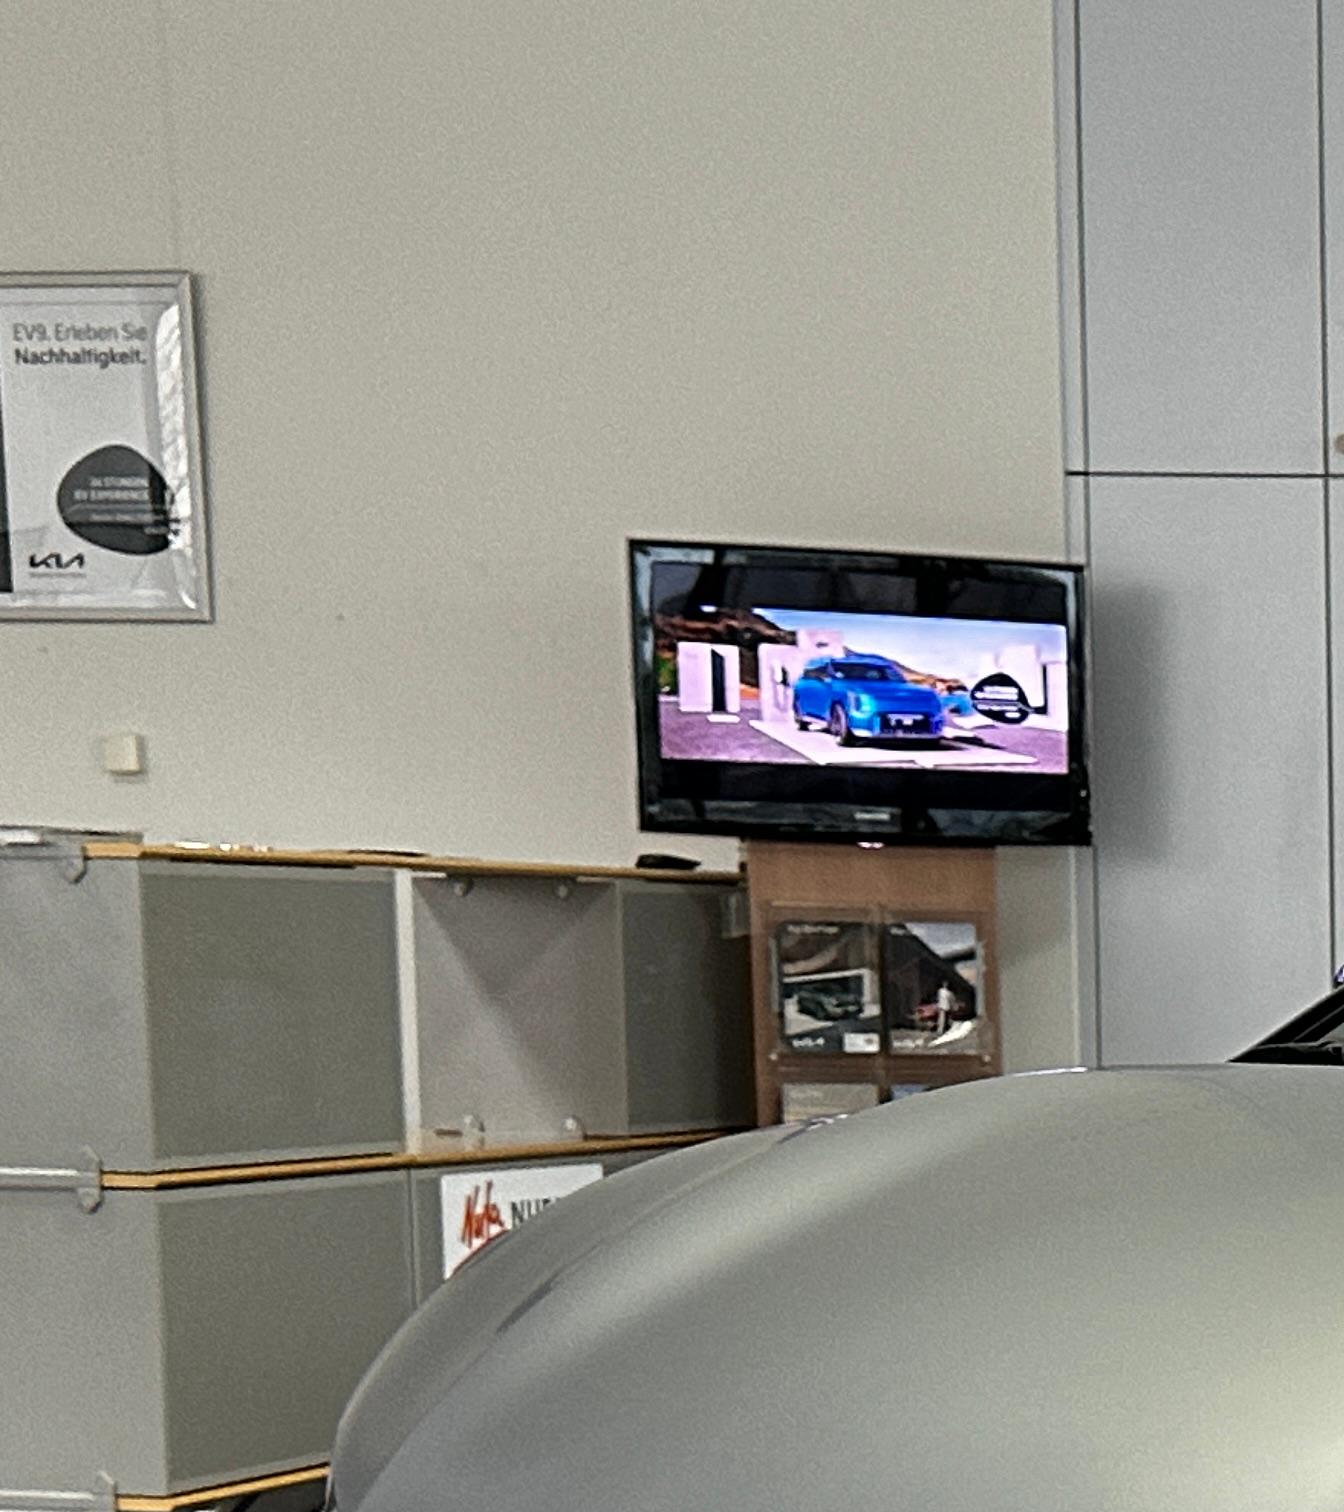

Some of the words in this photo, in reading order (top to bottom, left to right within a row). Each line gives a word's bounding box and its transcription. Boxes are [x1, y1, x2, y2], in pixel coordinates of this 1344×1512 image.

[13, 322, 50, 341] EV9.
[54, 322, 119, 341] Erleben
[14, 346, 147, 369] Nachhaltigkeit.
[29, 552, 84, 569] KIA
